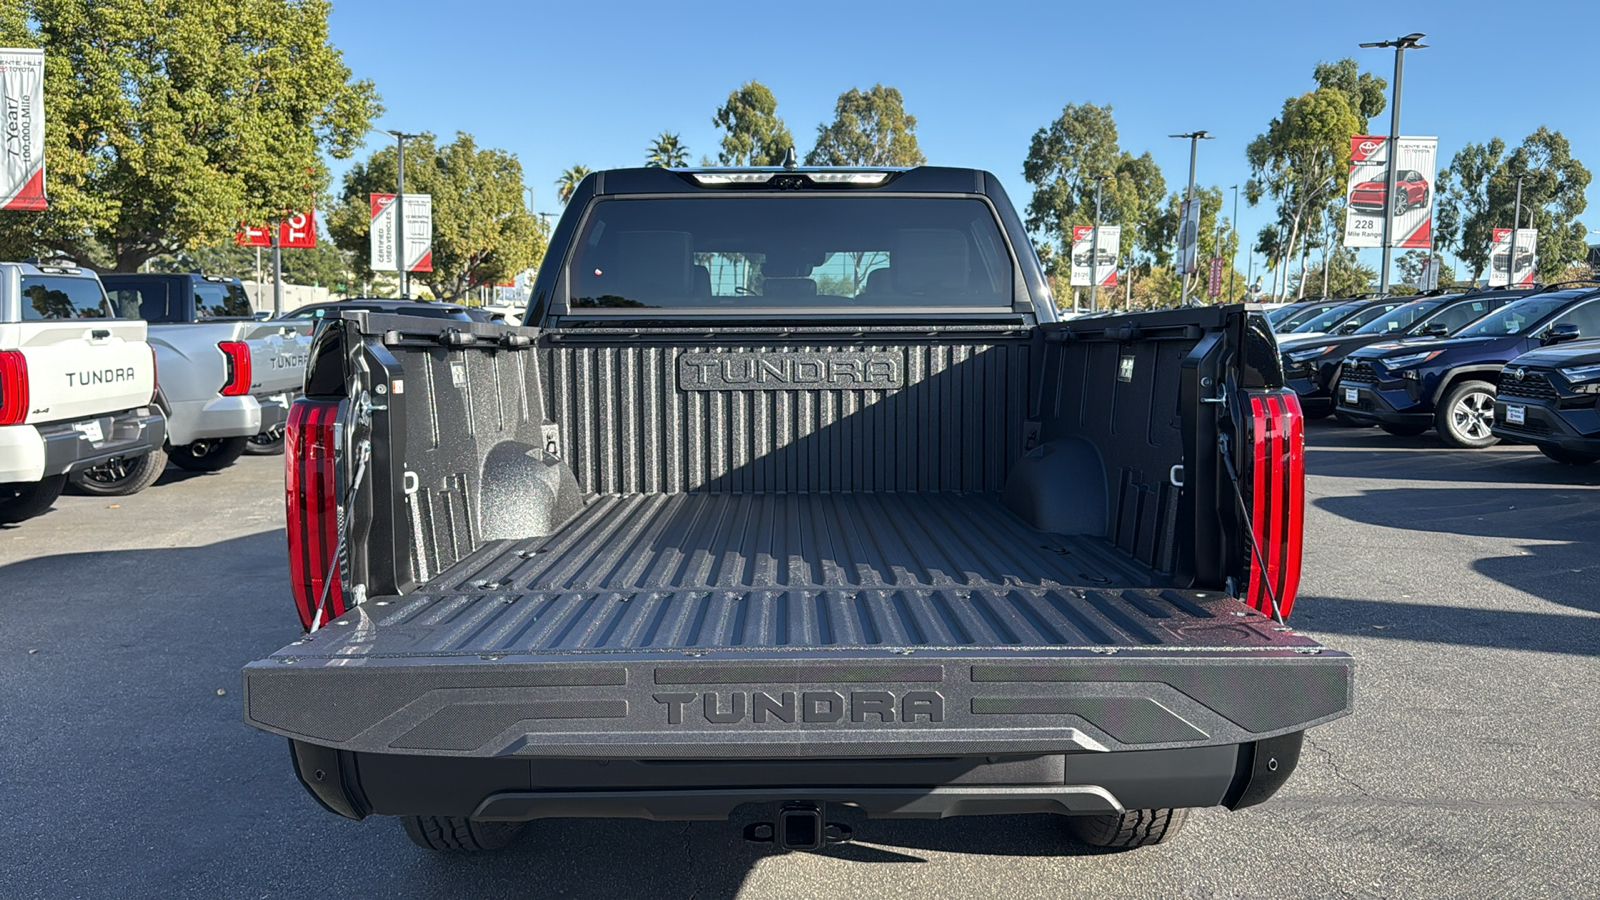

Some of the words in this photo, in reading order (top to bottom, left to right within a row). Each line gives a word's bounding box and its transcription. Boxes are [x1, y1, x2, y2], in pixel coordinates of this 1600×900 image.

[5, 95, 19, 142] Year/
[21, 94, 30, 118] Mile
[7, 148, 20, 158] 7
[22, 122, 31, 162] 100,000
[1354, 220, 1374, 229] 228
[65, 367, 134, 387] TUNDRA
[684, 358, 898, 384] TUNDRA
[652, 690, 945, 724] TUNDRA
